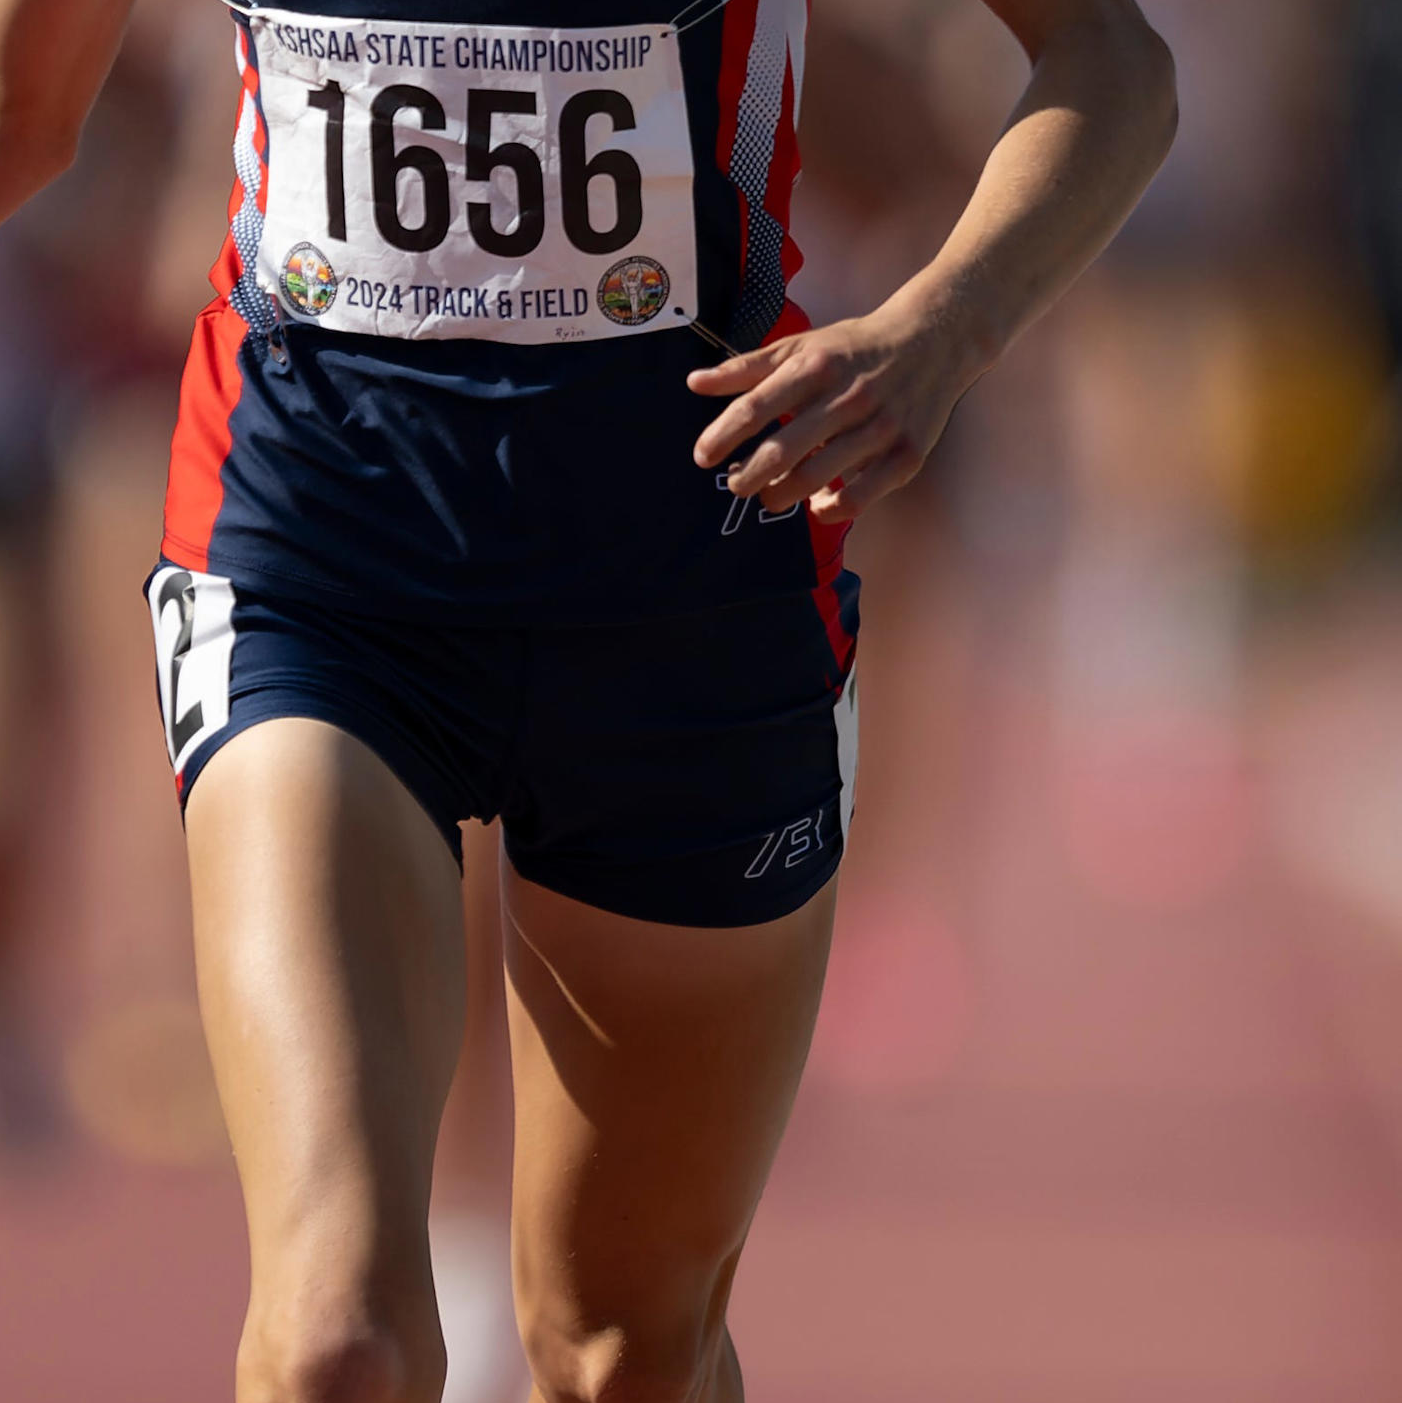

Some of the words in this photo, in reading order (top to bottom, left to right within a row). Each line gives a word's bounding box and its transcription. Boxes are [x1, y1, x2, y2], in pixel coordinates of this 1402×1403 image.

[366, 33, 445, 68] STATE
[454, 35, 652, 73] CHAMPIONSHIP
[308, 79, 642, 257] 1656
[347, 277, 403, 313] 2024
[409, 285, 489, 318] TRACK
[498, 289, 512, 319] &
[521, 288, 588, 318] FIELD
